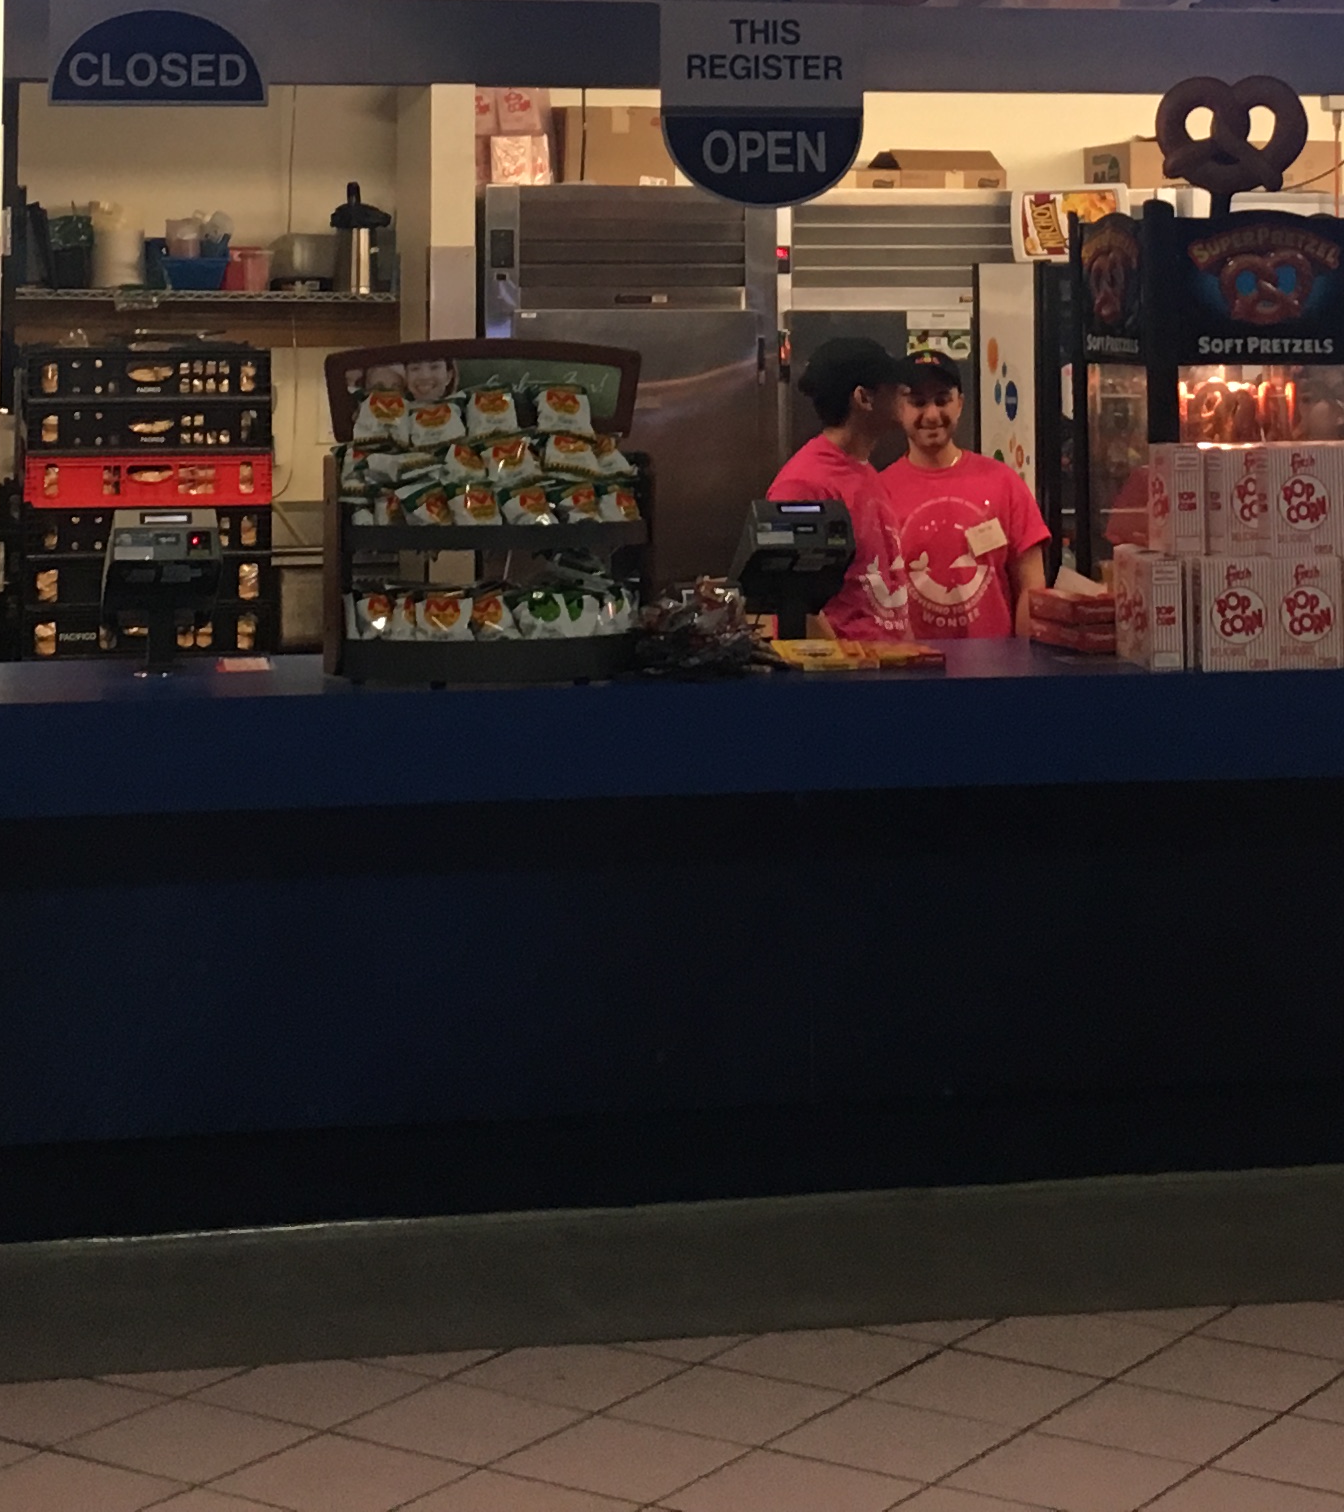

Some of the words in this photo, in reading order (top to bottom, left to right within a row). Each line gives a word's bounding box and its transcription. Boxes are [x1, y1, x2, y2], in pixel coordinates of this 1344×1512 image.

[729, 19, 801, 45] THIS
[69, 52, 247, 87] CLOSED
[687, 54, 843, 80] REGISTER
[702, 129, 827, 174] OPEN
[1031, 203, 1065, 248] NACHOS
[1192, 231, 1256, 263] SUPER
[1198, 336, 1244, 354] SOFT
[1247, 335, 1334, 354] PRETZELS
[1280, 479, 1315, 505] POP
[1286, 496, 1326, 523] CORN
[1216, 591, 1251, 618] POP
[1284, 590, 1320, 617] POP
[1220, 608, 1263, 636] CORN
[1289, 607, 1332, 635] CORN
